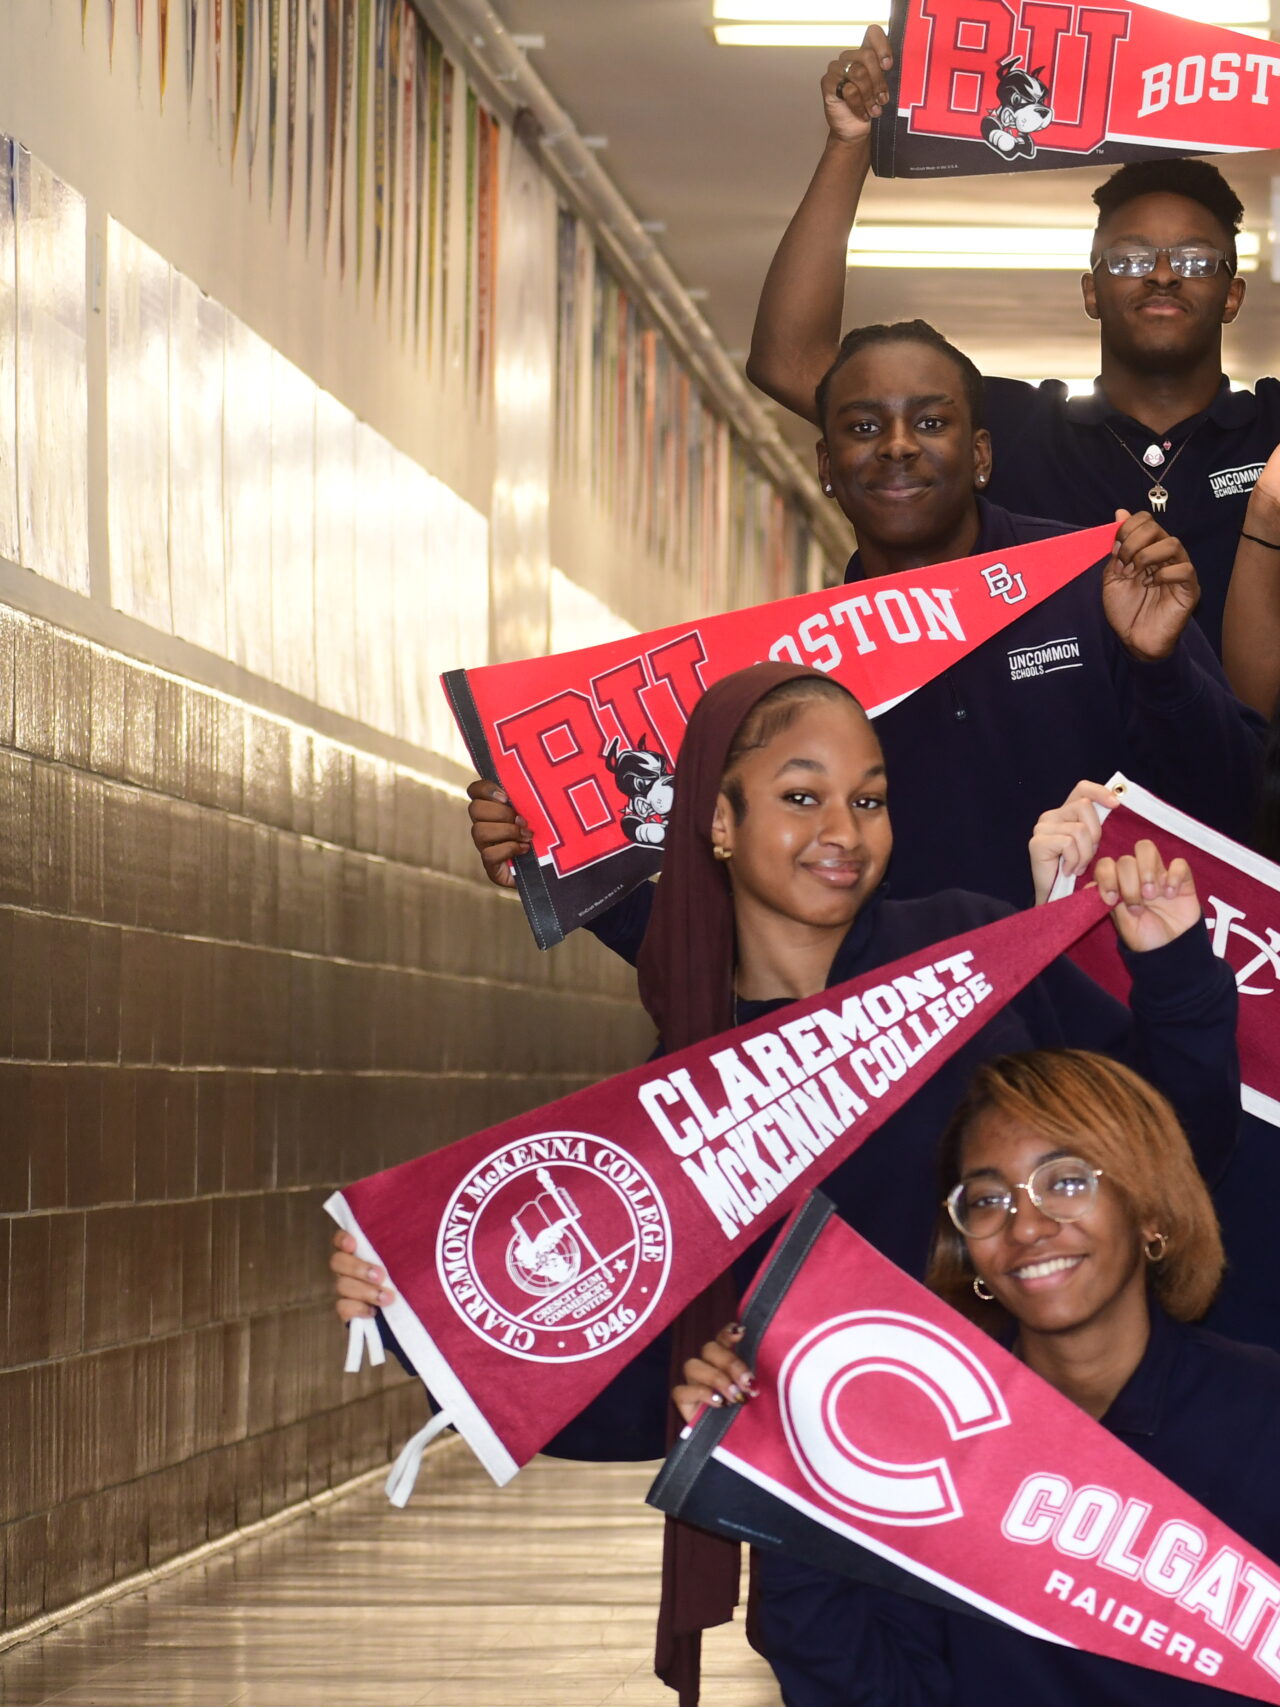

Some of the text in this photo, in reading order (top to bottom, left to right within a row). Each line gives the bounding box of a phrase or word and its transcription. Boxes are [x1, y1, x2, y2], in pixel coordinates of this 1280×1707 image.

[908, 0, 1131, 155] BU
[1210, 467, 1264, 490] UNCOMMO
[1214, 485, 1244, 498] SCHOOLS
[980, 562, 1028, 605] BU
[754, 587, 967, 673] OSTON
[1009, 643, 1080, 670] UNCOMMON
[1011, 665, 1044, 680] SCHOOLS
[637, 949, 975, 1158] CLAREMONT
[849, 971, 994, 1099] COLLEGE
[443, 1137, 665, 1351] CLAREMONT McKENNA COLLEGE
[582, 1303, 637, 1349] 1946
[776, 1308, 1012, 1528] C
[1044, 1568, 1224, 1677] RAIDERS
